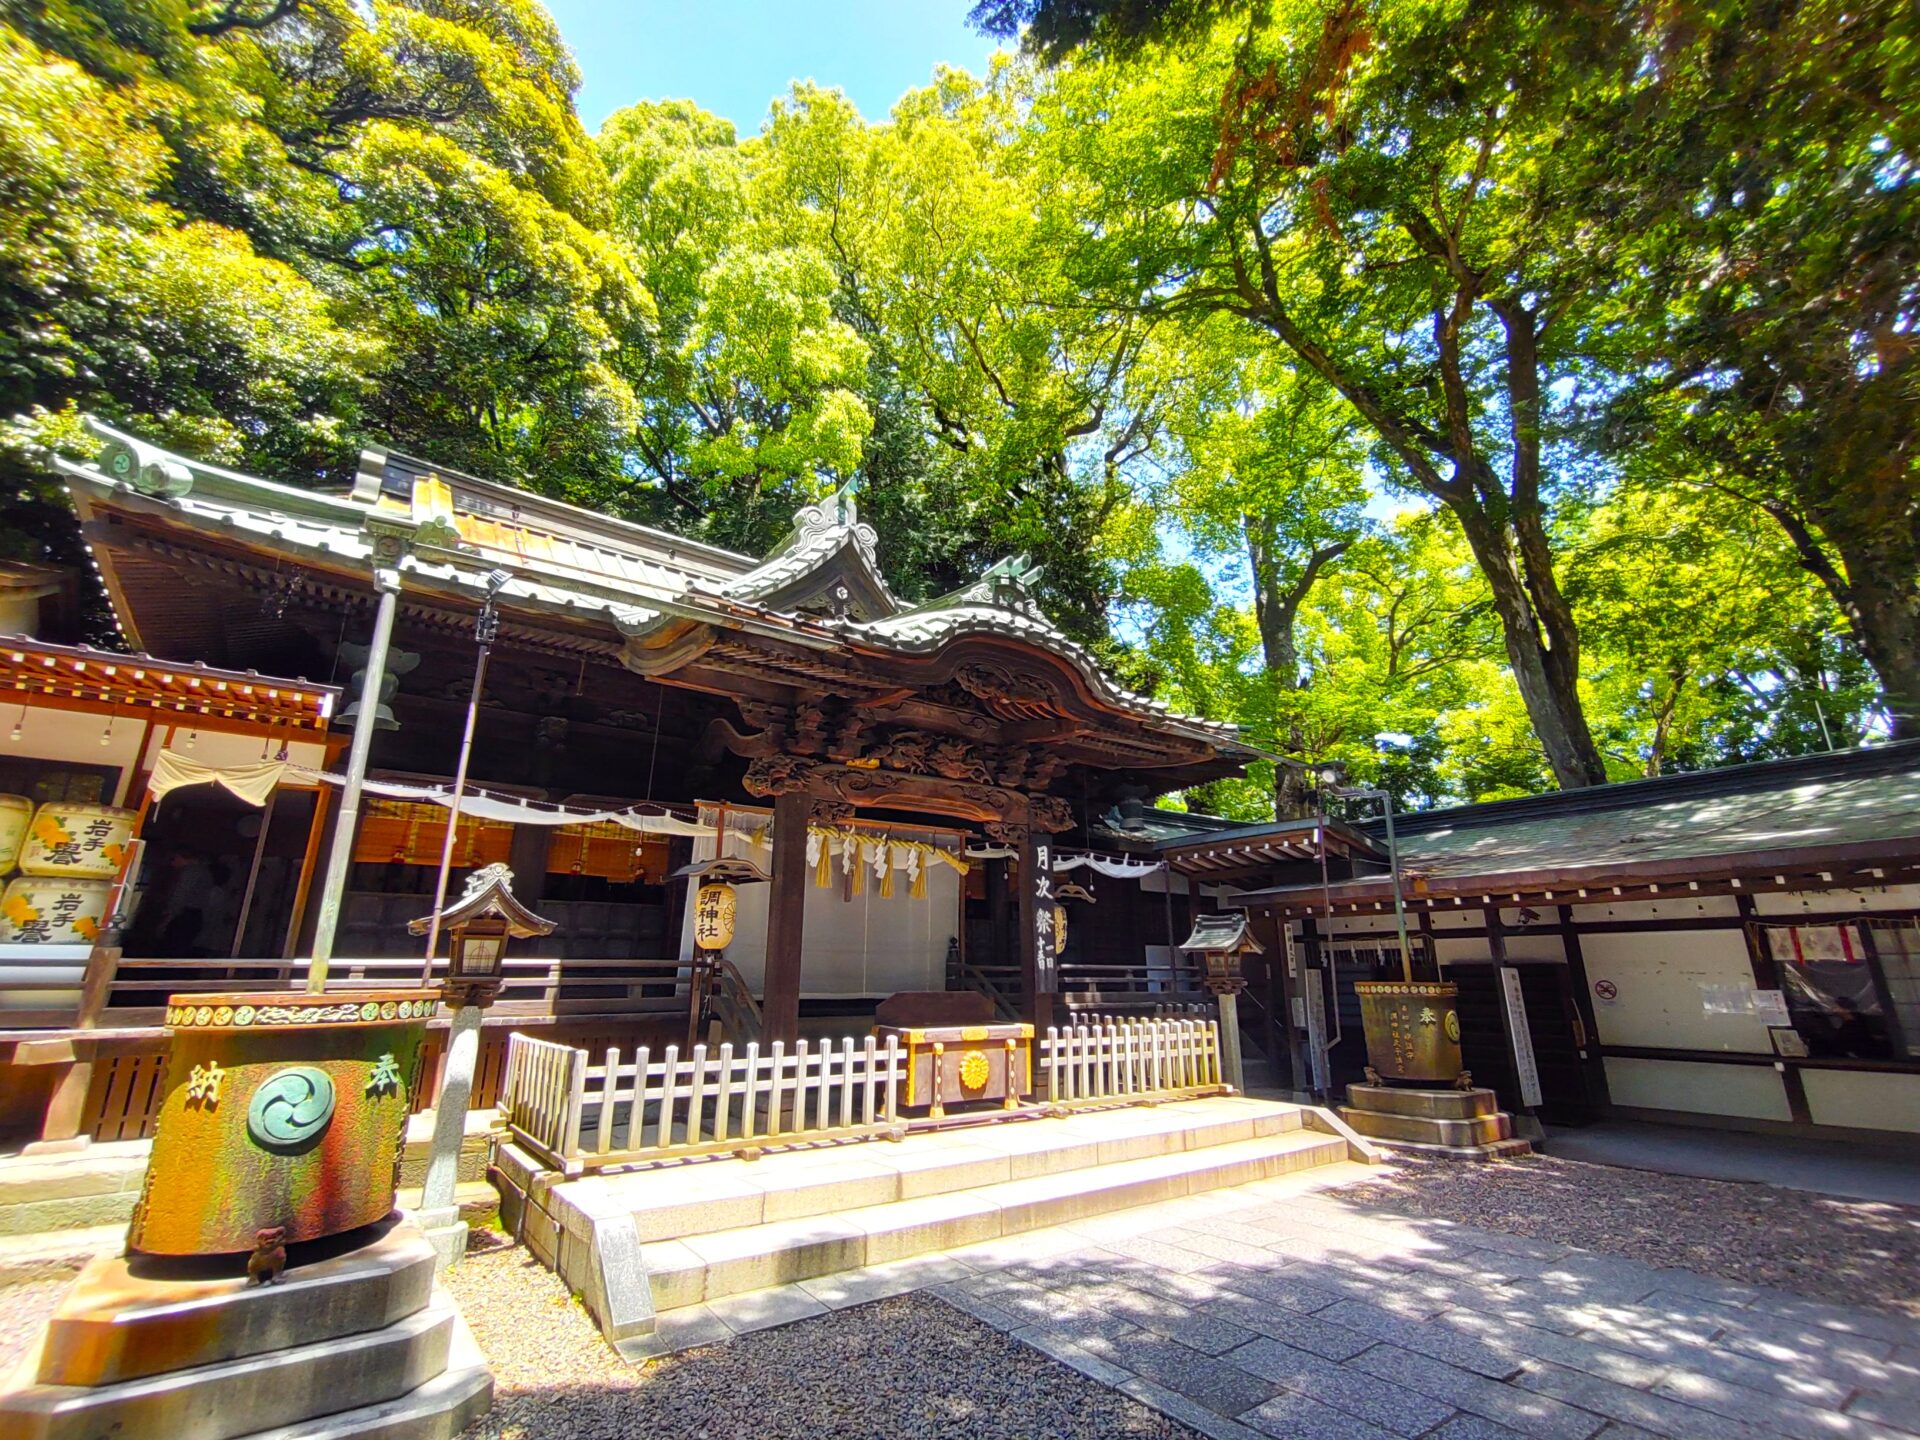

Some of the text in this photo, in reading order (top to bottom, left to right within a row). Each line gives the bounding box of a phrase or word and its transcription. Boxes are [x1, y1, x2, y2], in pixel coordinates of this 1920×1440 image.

[83, 819, 114, 852] 岩手
[1035, 845, 1055, 934] 月次祭
[52, 893, 84, 927] 岩手
[697, 889, 722, 942] 調神社
[1419, 1007, 1438, 1024] 奉
[185, 1060, 226, 1103] 納
[363, 1053, 400, 1092] 奉
